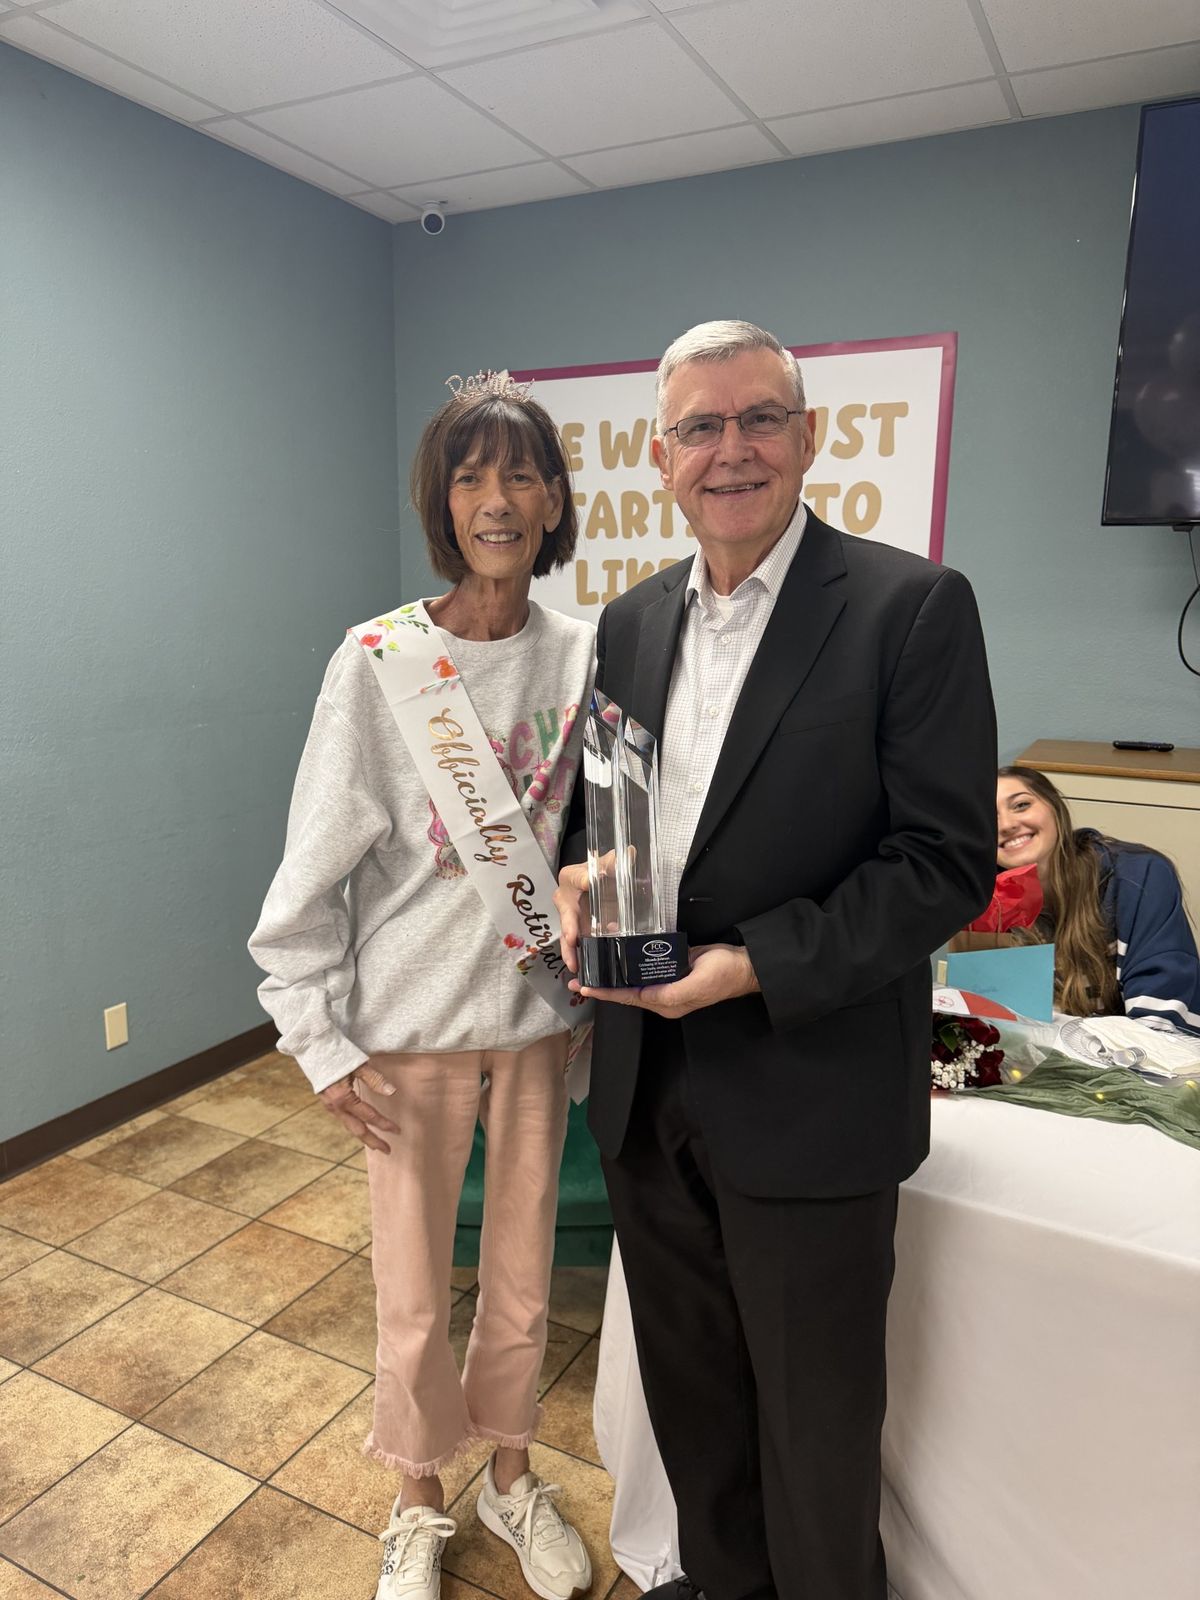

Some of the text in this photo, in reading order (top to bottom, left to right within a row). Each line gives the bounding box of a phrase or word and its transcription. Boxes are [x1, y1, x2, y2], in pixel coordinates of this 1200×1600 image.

[561, 401, 909, 472] E W ST
[804, 481, 882, 535] TO
[576, 557, 682, 606] LIK
[428, 707, 518, 867] Officially
[506, 873, 568, 979] Retired!
